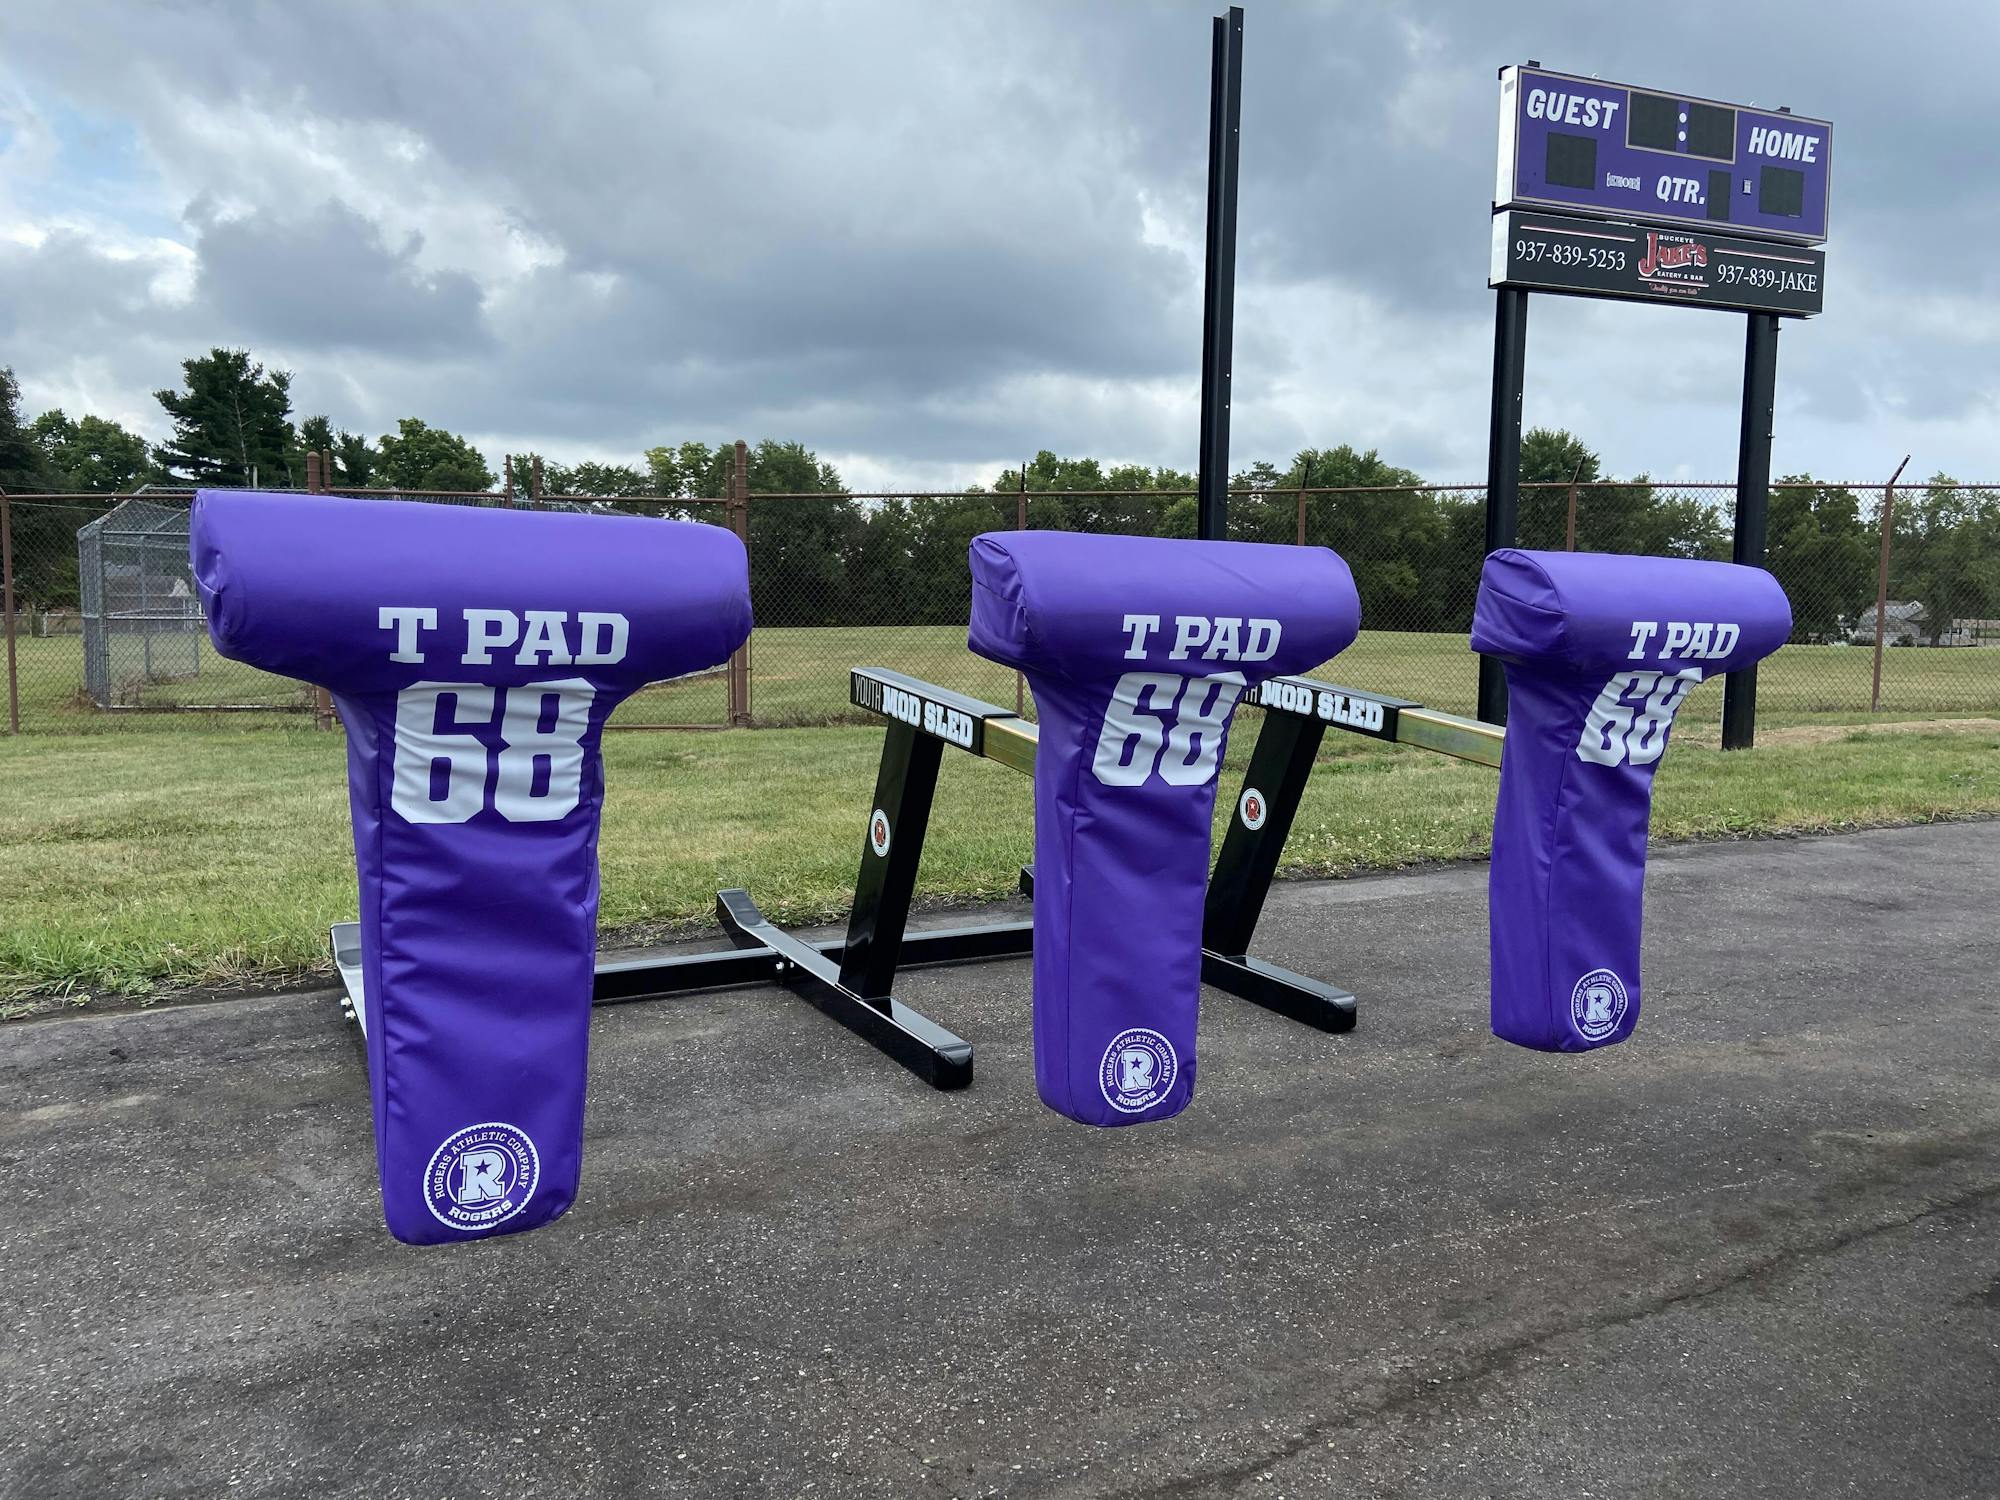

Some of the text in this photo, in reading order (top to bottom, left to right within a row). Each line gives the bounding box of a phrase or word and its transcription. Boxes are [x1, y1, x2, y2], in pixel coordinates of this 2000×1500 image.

[1526, 88, 1620, 130] GUEST
[1748, 126, 1820, 163] HOME
[1656, 175, 1706, 205] QTR.
[1515, 240, 1626, 271] 937-839-5253
[1658, 234, 1694, 244] BUCKEYE
[1657, 270, 1682, 279] EATERY
[1717, 263, 1818, 293] 937-839-JAKE
[378, 606, 630, 666] T PAD
[1122, 614, 1283, 662] T PAD
[1627, 621, 1741, 660] T PAD
[854, 673, 974, 749] YOUTH MOD SLED
[1260, 679, 1313, 716] MOD
[1317, 691, 1385, 732] SLED
[1575, 666, 1703, 768] 68
[1091, 671, 1248, 787] 68
[391, 676, 598, 825] 68
[1586, 986, 1612, 1023] R
[1106, 1035, 1171, 1088] ROGERS ATHLETIC COMPANY
[1121, 1049, 1154, 1092] R
[1115, 1090, 1157, 1107] ROGERS
[434, 1131, 530, 1200] ROGERS ATHLETIC COMPANY
[458, 1148, 507, 1204] R
[448, 1199, 513, 1222] ROGERS
